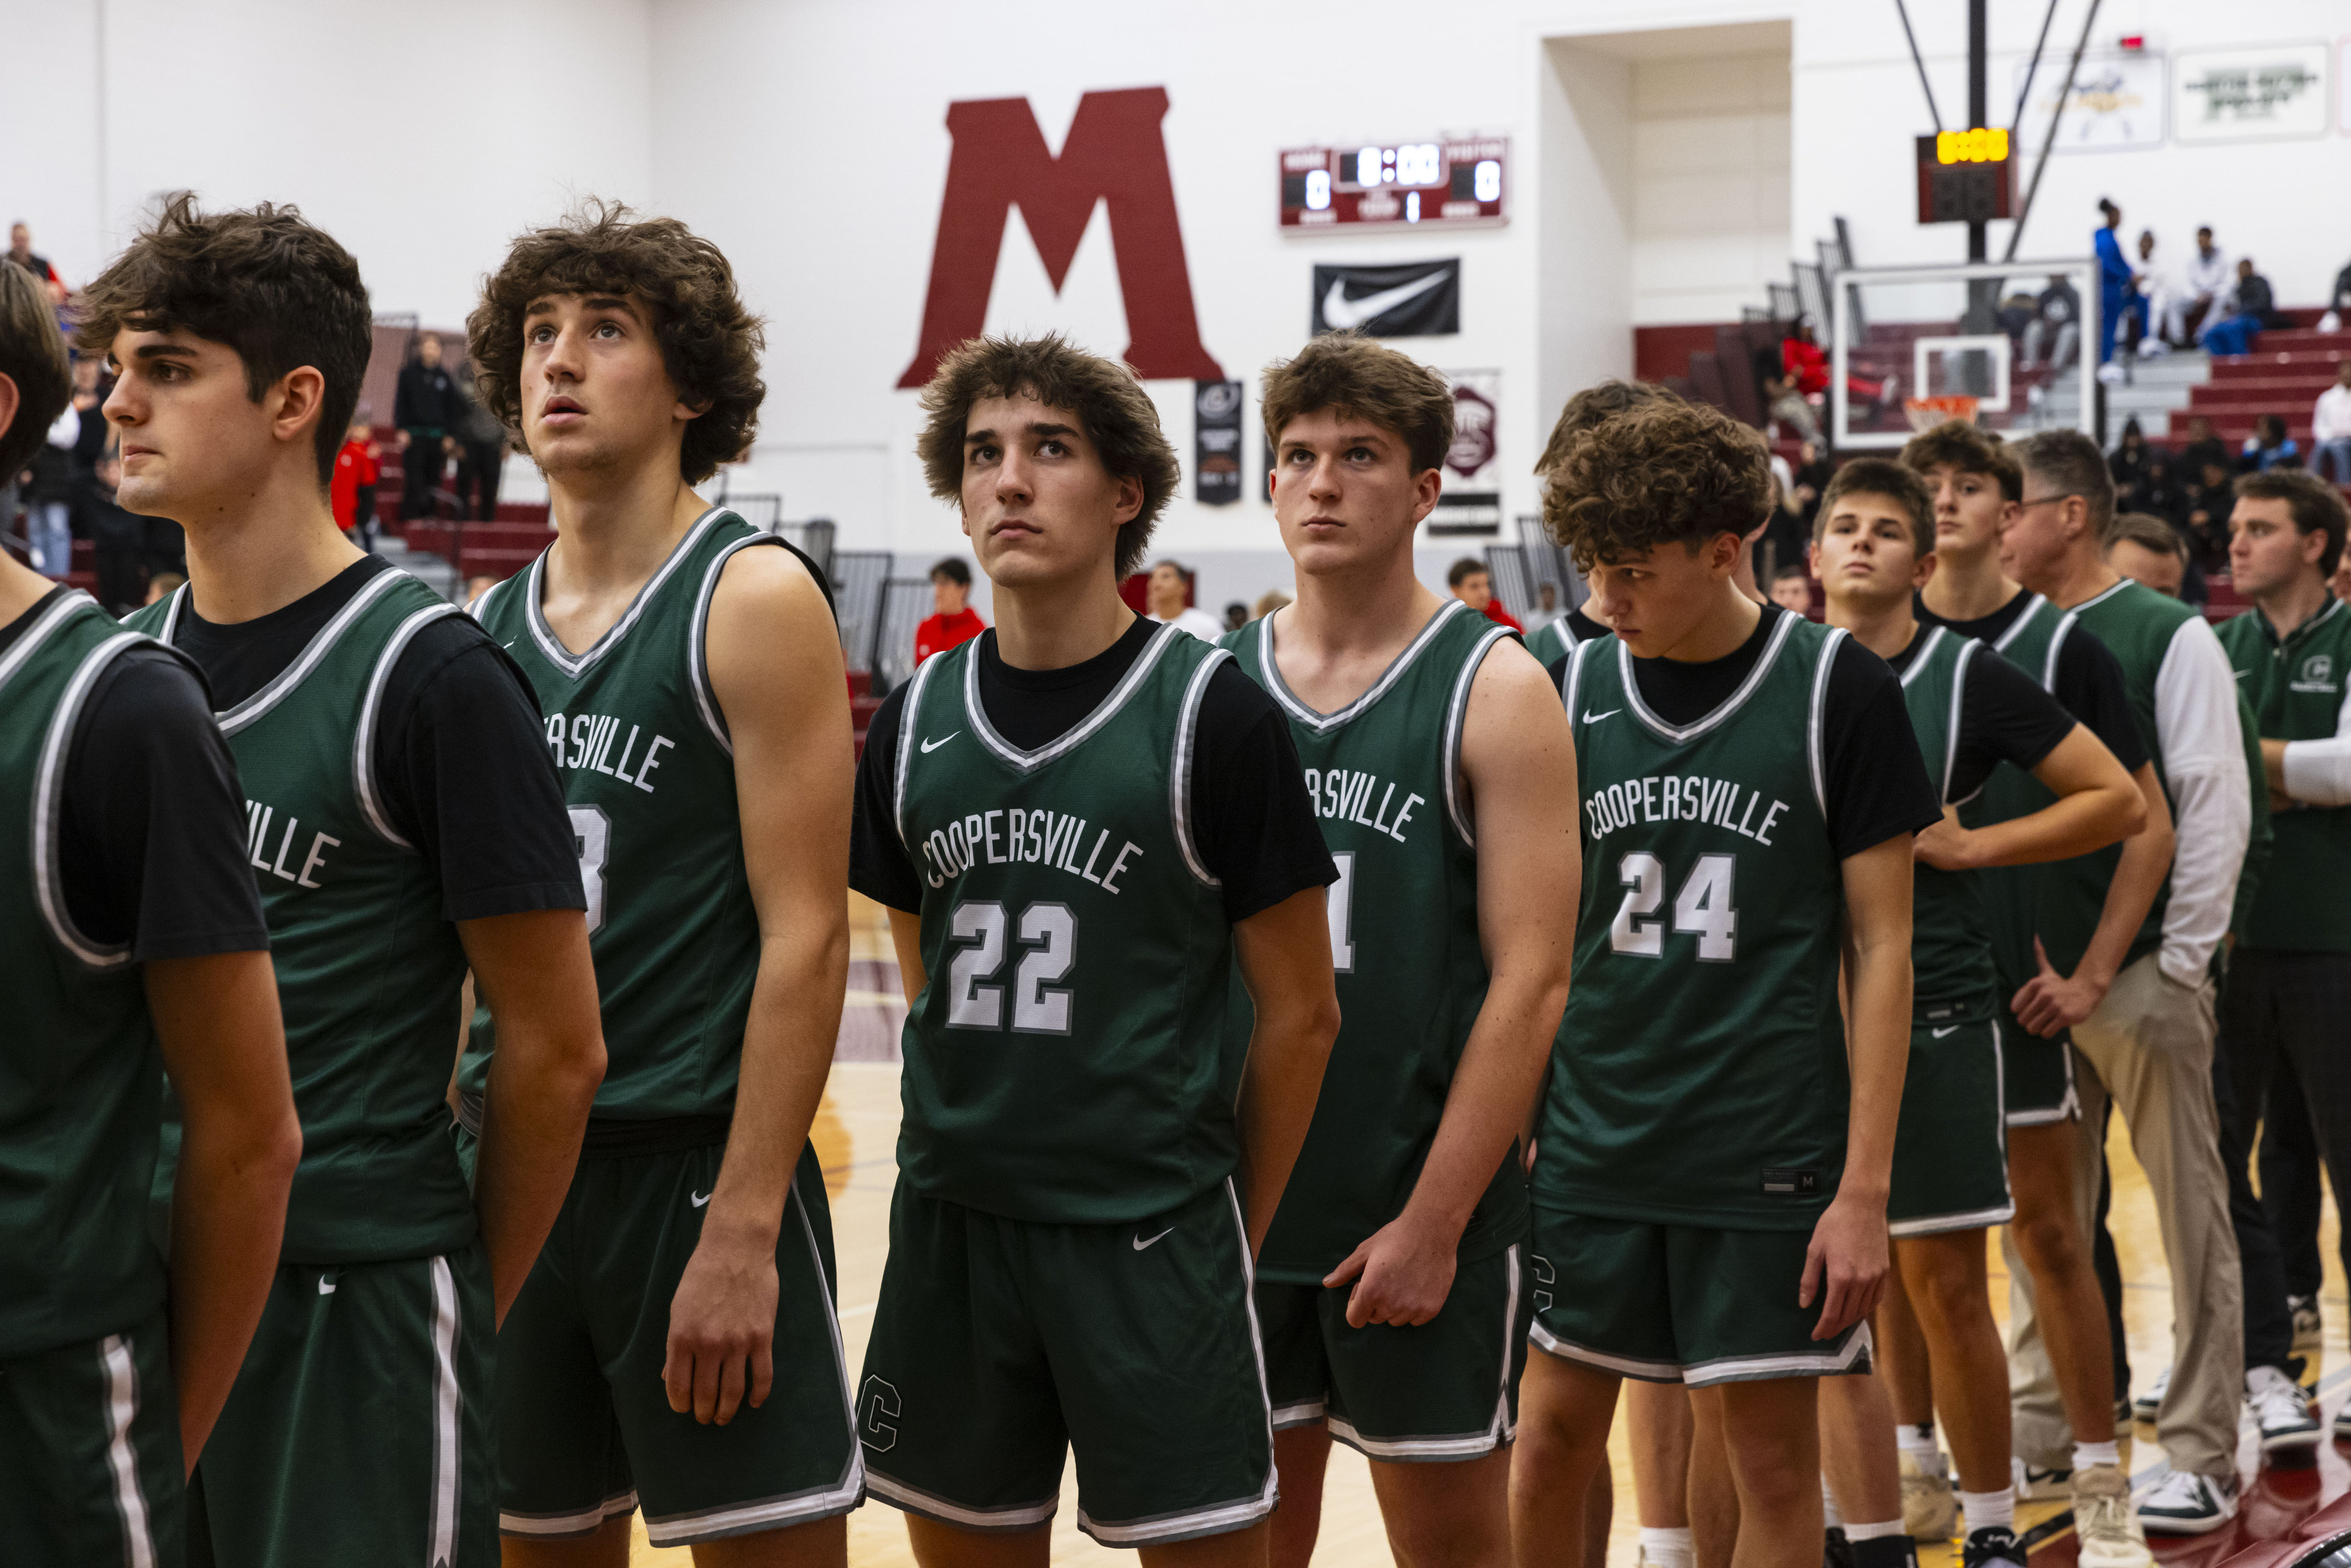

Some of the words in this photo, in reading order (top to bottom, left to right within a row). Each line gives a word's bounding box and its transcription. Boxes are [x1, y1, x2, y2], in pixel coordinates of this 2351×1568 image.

[894, 86, 1227, 388] M
[923, 808, 1143, 895] COOPERSVILLE
[1586, 776, 1789, 846] COOPERSVILLE
[1609, 850, 1739, 963] 24
[945, 900, 1078, 1036] 22
[857, 1374, 901, 1452] C
